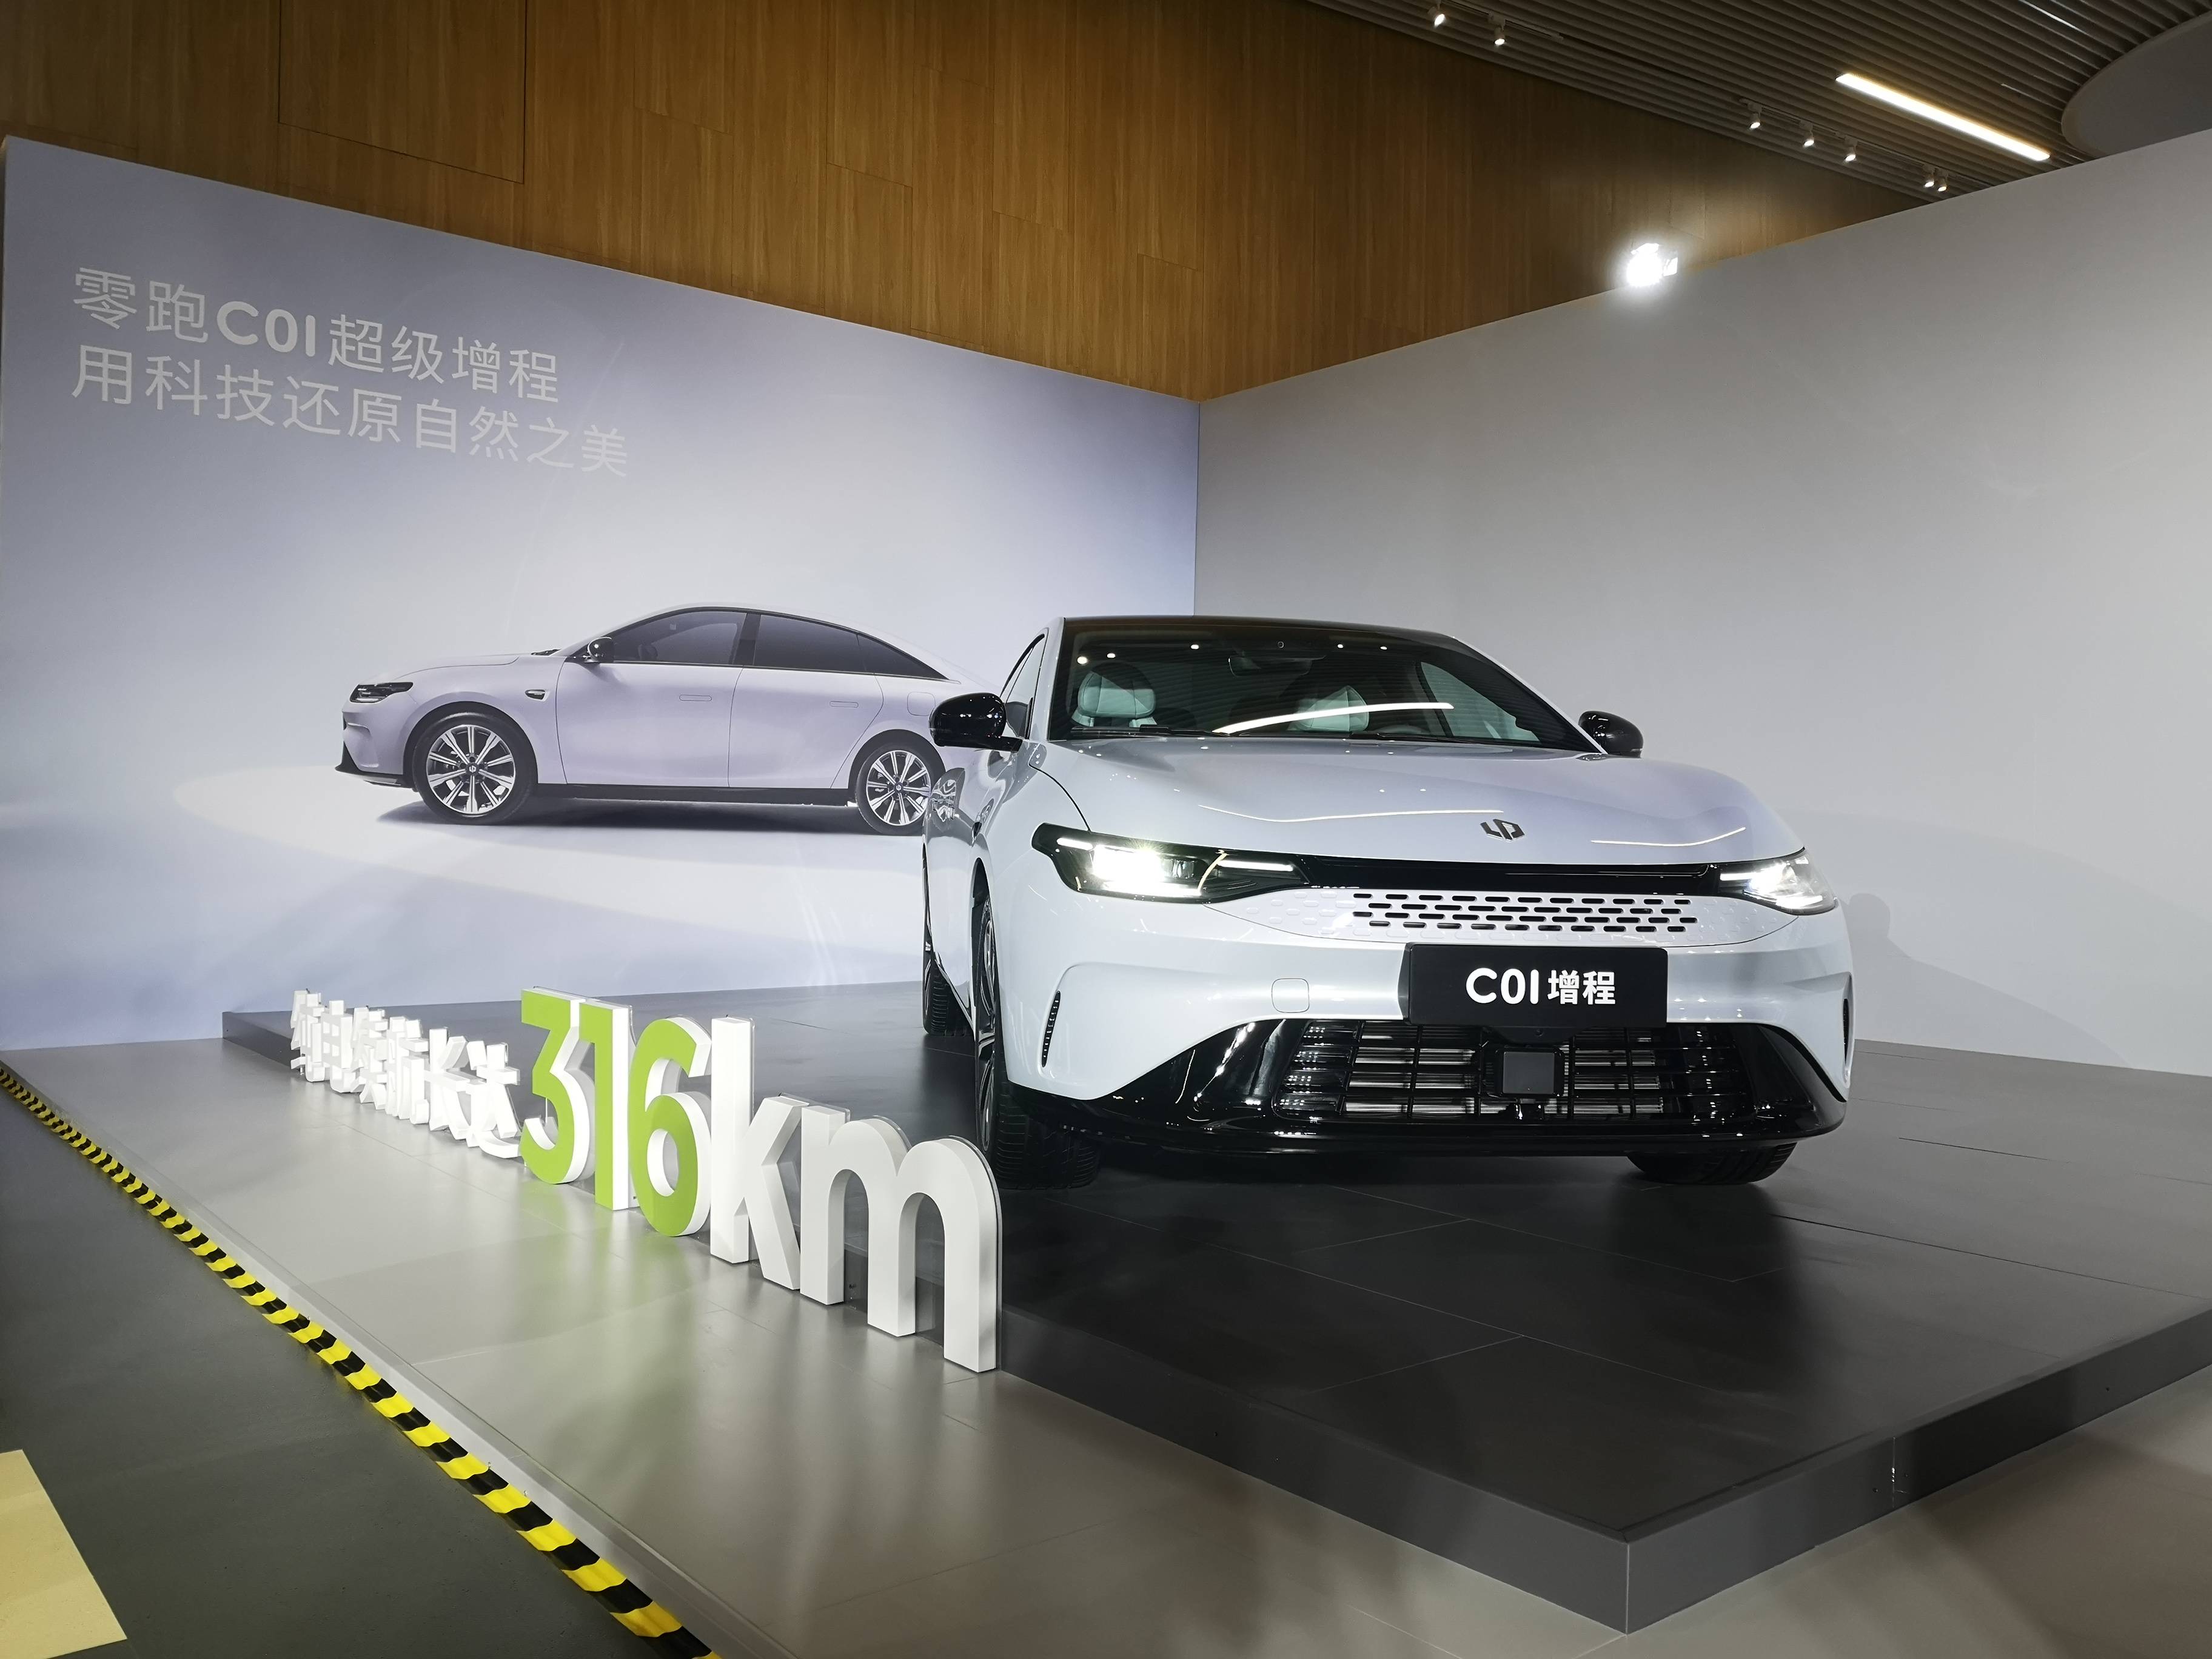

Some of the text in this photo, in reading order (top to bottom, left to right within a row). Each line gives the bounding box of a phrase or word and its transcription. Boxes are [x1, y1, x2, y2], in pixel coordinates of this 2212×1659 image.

[71, 344, 628, 477] 用科技还原自然之美
